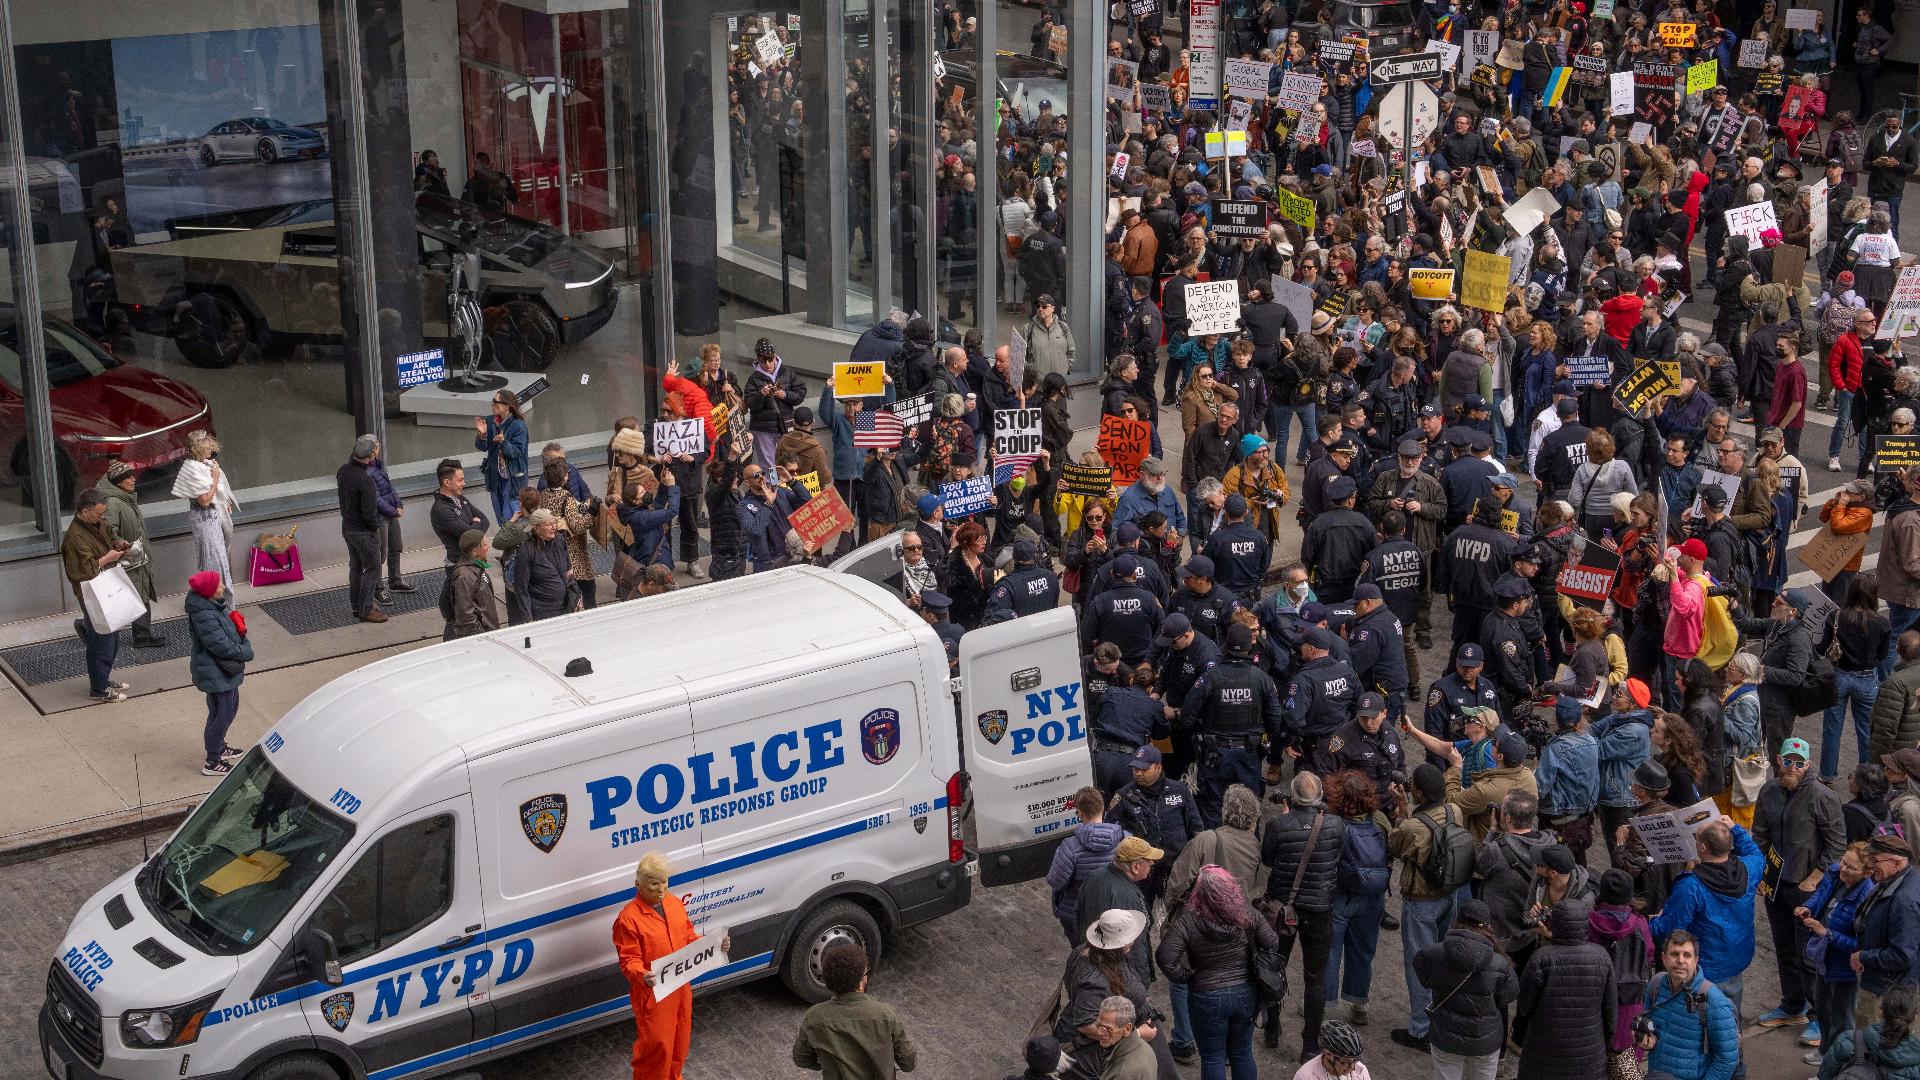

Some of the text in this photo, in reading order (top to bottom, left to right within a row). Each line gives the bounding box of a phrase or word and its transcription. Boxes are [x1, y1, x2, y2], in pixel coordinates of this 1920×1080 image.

[1132, 4, 1156, 15] RESIST
[1193, 7, 1199, 16] 3
[1663, 26, 1691, 34] STOP
[1480, 36, 1488, 44] TO
[1663, 37, 1691, 45] COUP
[1473, 44, 1489, 52] 1939
[1192, 53, 1199, 62] 2
[1231, 65, 1261, 75] GLOBAL
[1380, 60, 1435, 76] ONE WAY
[1633, 62, 1647, 70] WE
[1225, 75, 1269, 88] DISGRACE
[1633, 74, 1674, 85] FASCIST
[1281, 191, 1310, 208] NOBODY
[1220, 204, 1258, 215] DEFEND
[1286, 208, 1307, 223] MUSK
[1388, 202, 1403, 214] TESLA
[1232, 217, 1246, 225] THE
[1212, 225, 1267, 234] CONSTITUTION
[1411, 272, 1453, 280] BOYCOTT
[1903, 268, 1916, 277] HEY
[1188, 283, 1233, 298] DEFEND
[1199, 294, 1222, 303] OUR
[1187, 299, 1239, 315] AMERICAN
[1191, 311, 1231, 325] WAY OF
[398, 350, 443, 366] BILLIONAIRES
[413, 359, 430, 370] ARE
[400, 365, 442, 380] STEALING
[845, 365, 873, 375] JUNK
[401, 371, 444, 388] FROM YOU
[1619, 366, 1656, 398] WTF?
[1628, 377, 1667, 415] MUSK
[919, 403, 934, 414] WHO
[995, 410, 1042, 430] STOP
[656, 419, 701, 440] NAZI
[1101, 418, 1146, 442] SEND
[657, 440, 700, 456] SCUM
[996, 435, 1042, 455] COUP
[1098, 438, 1142, 455] ELON
[1885, 440, 1907, 448] Trump
[1112, 453, 1128, 463] TO
[1877, 450, 1909, 458] shredding
[1063, 465, 1111, 475] OVERTHROW
[941, 477, 989, 494] YOU WILL
[1079, 476, 1111, 484] SHADOW
[946, 484, 987, 499] PAY FOR
[943, 493, 989, 508] BILLIONAIRES
[795, 495, 830, 524] NO ONE
[945, 506, 966, 516] TAX
[800, 508, 832, 532] VOTED FOR
[806, 517, 842, 541] MUSK
[1232, 541, 1255, 553] NYPD
[1455, 538, 1491, 562] NYPD
[1383, 550, 1421, 566] NYPD
[1384, 563, 1420, 574] POLICE
[1027, 578, 1048, 592] NYPD
[1384, 578, 1420, 590] LEGAL
[1562, 568, 1611, 594] FASCIST
[1113, 598, 1141, 610] NYPD
[1325, 677, 1347, 692] NYPD
[1026, 683, 1081, 719] NY
[1221, 688, 1251, 699] NYPD
[864, 711, 895, 729] POLICE
[264, 731, 286, 754] NYPD
[1010, 715, 1087, 756] POL
[586, 718, 845, 830] POLICE
[329, 786, 362, 816] NYPD
[531, 796, 555, 808] POLICE
[1027, 800, 1056, 813] $10,000
[523, 801, 564, 819] DEPARTMENT
[611, 777, 828, 849] STRATEGIC RESPONSE GROUP
[909, 802, 928, 817] 1959
[1034, 820, 1061, 834] KEEP
[1638, 820, 1675, 832] UGLIER
[681, 885, 735, 907] COURTESY
[688, 886, 766, 918] OFESSIONALISM
[82, 939, 115, 970] NYPD
[62, 946, 105, 993] POLICE
[660, 943, 715, 985] FELON
[367, 937, 536, 1024] NYPD
[222, 992, 280, 1022] POLICE
